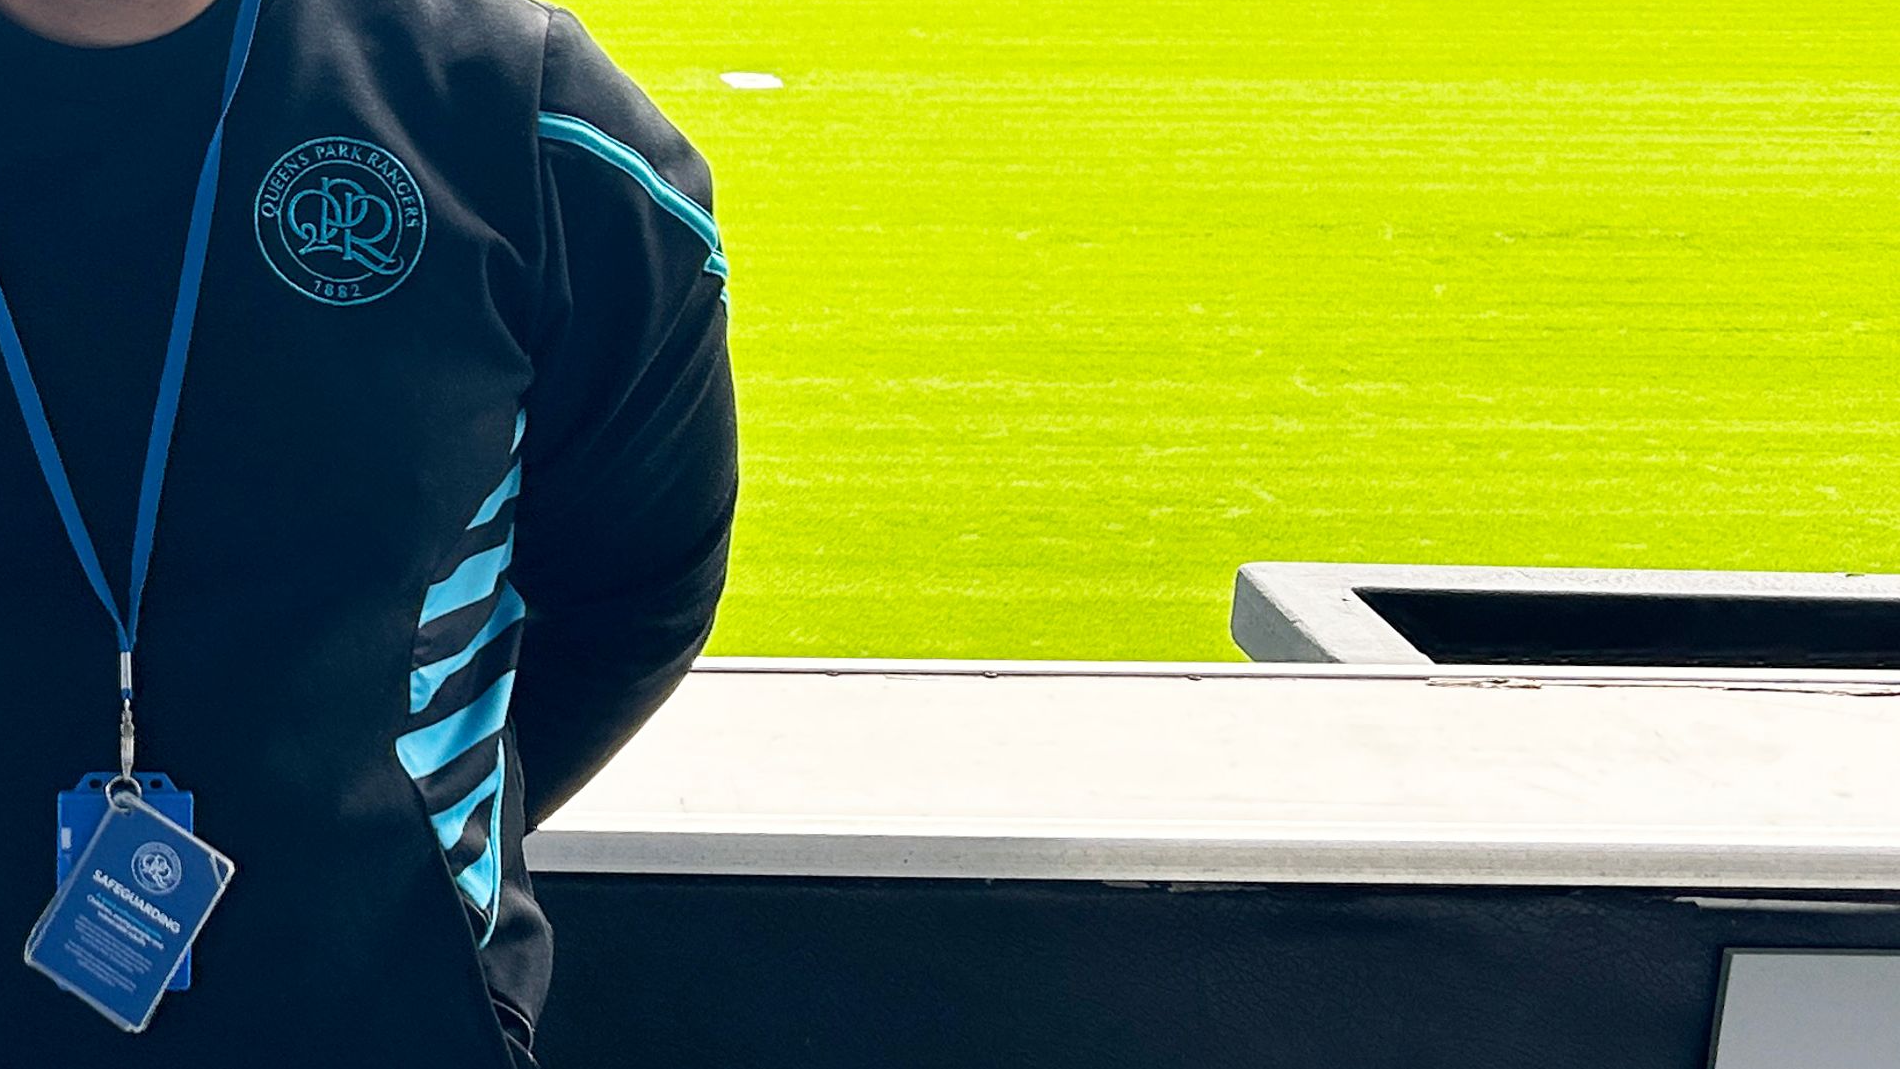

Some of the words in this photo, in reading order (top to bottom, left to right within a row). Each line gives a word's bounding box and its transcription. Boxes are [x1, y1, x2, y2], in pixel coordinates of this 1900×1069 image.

[261, 152, 310, 218] QUEENS
[315, 144, 362, 161] PARK
[366, 152, 420, 228] RANGERS
[313, 280, 363, 298] 1882
[93, 869, 181, 934] SAFEGUARDING
